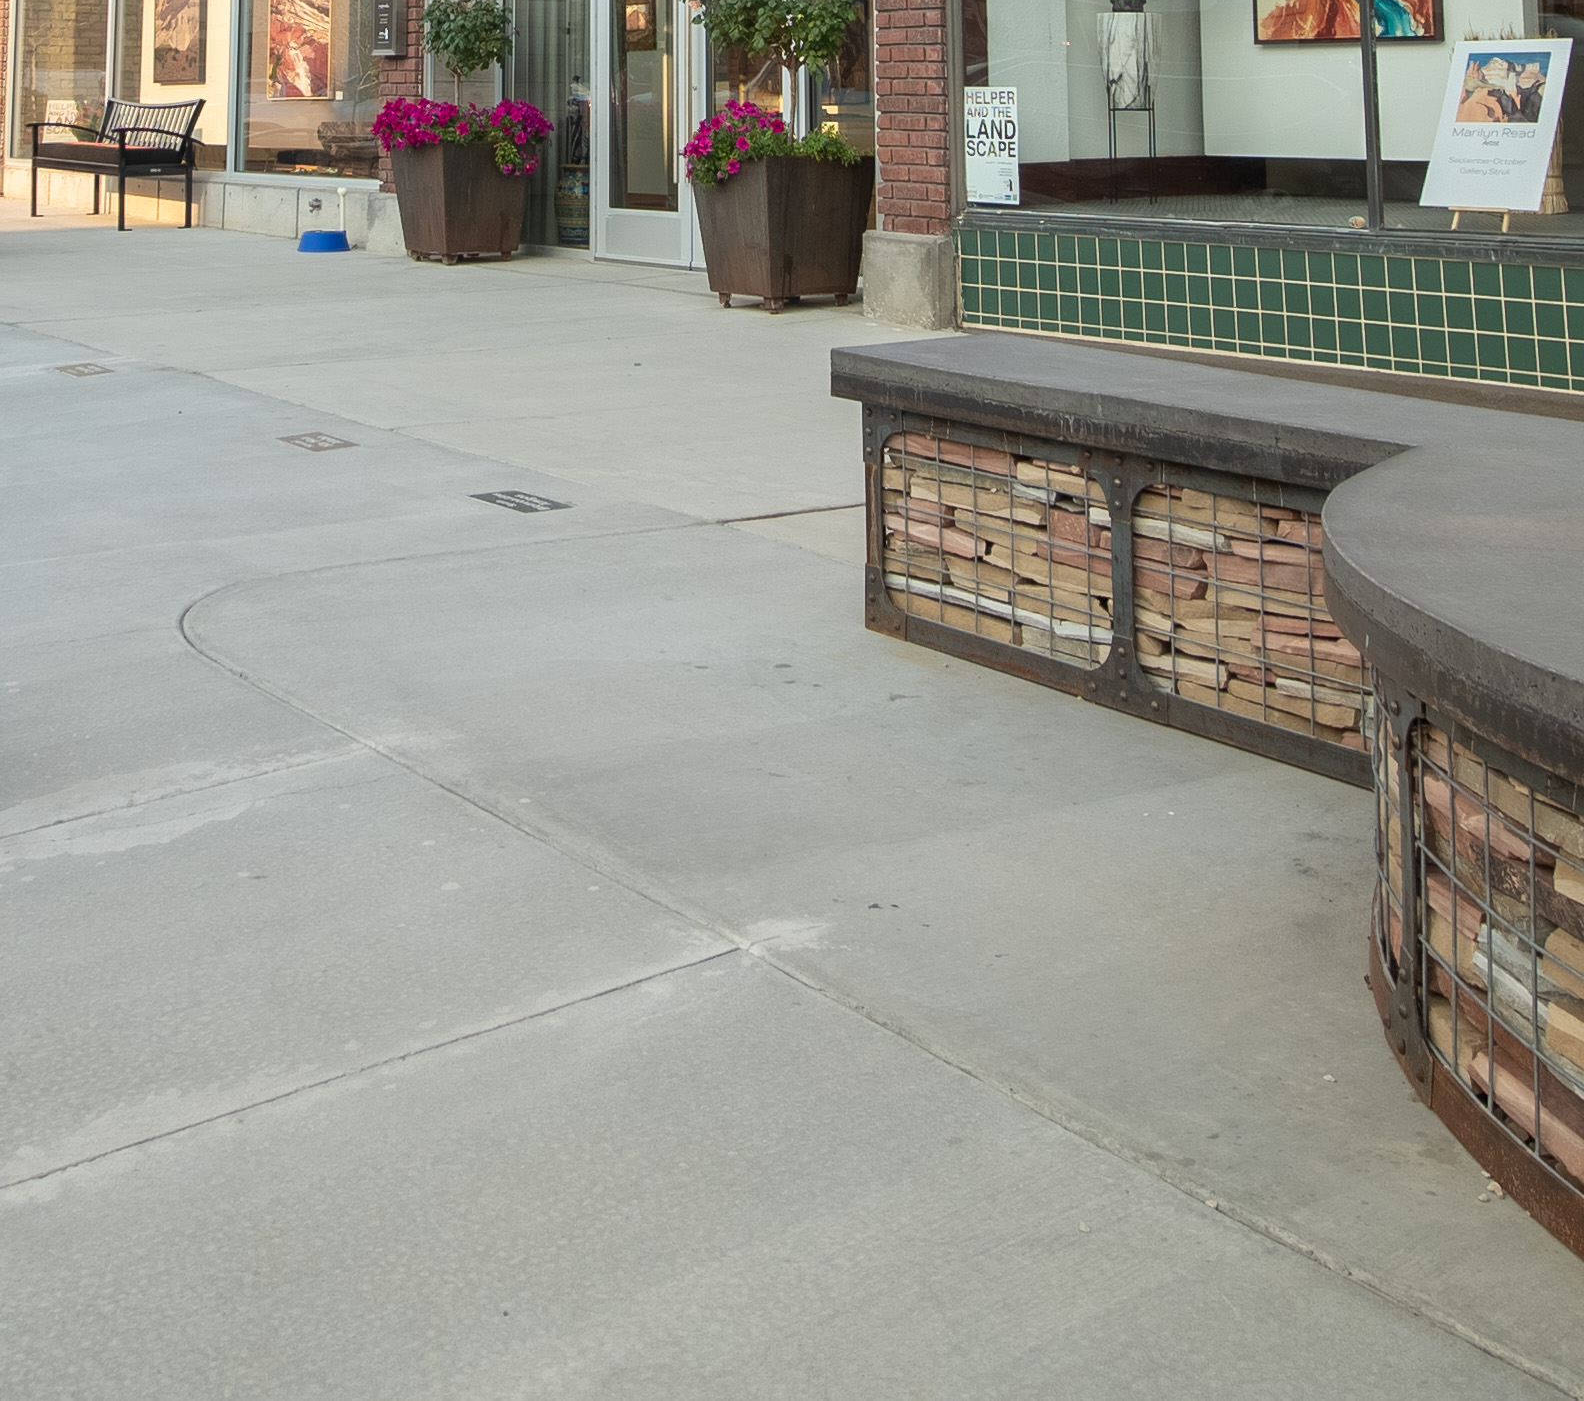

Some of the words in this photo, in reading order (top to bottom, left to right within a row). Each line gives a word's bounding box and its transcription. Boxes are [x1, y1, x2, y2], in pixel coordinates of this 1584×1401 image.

[966, 90, 1015, 105] HELPER
[967, 106, 989, 118] AND
[991, 106, 1012, 118] THE
[966, 119, 1016, 140] LAND
[1452, 127, 1499, 140] Marilyn
[1501, 127, 1536, 139] Read
[967, 140, 1016, 158] SCAPE
